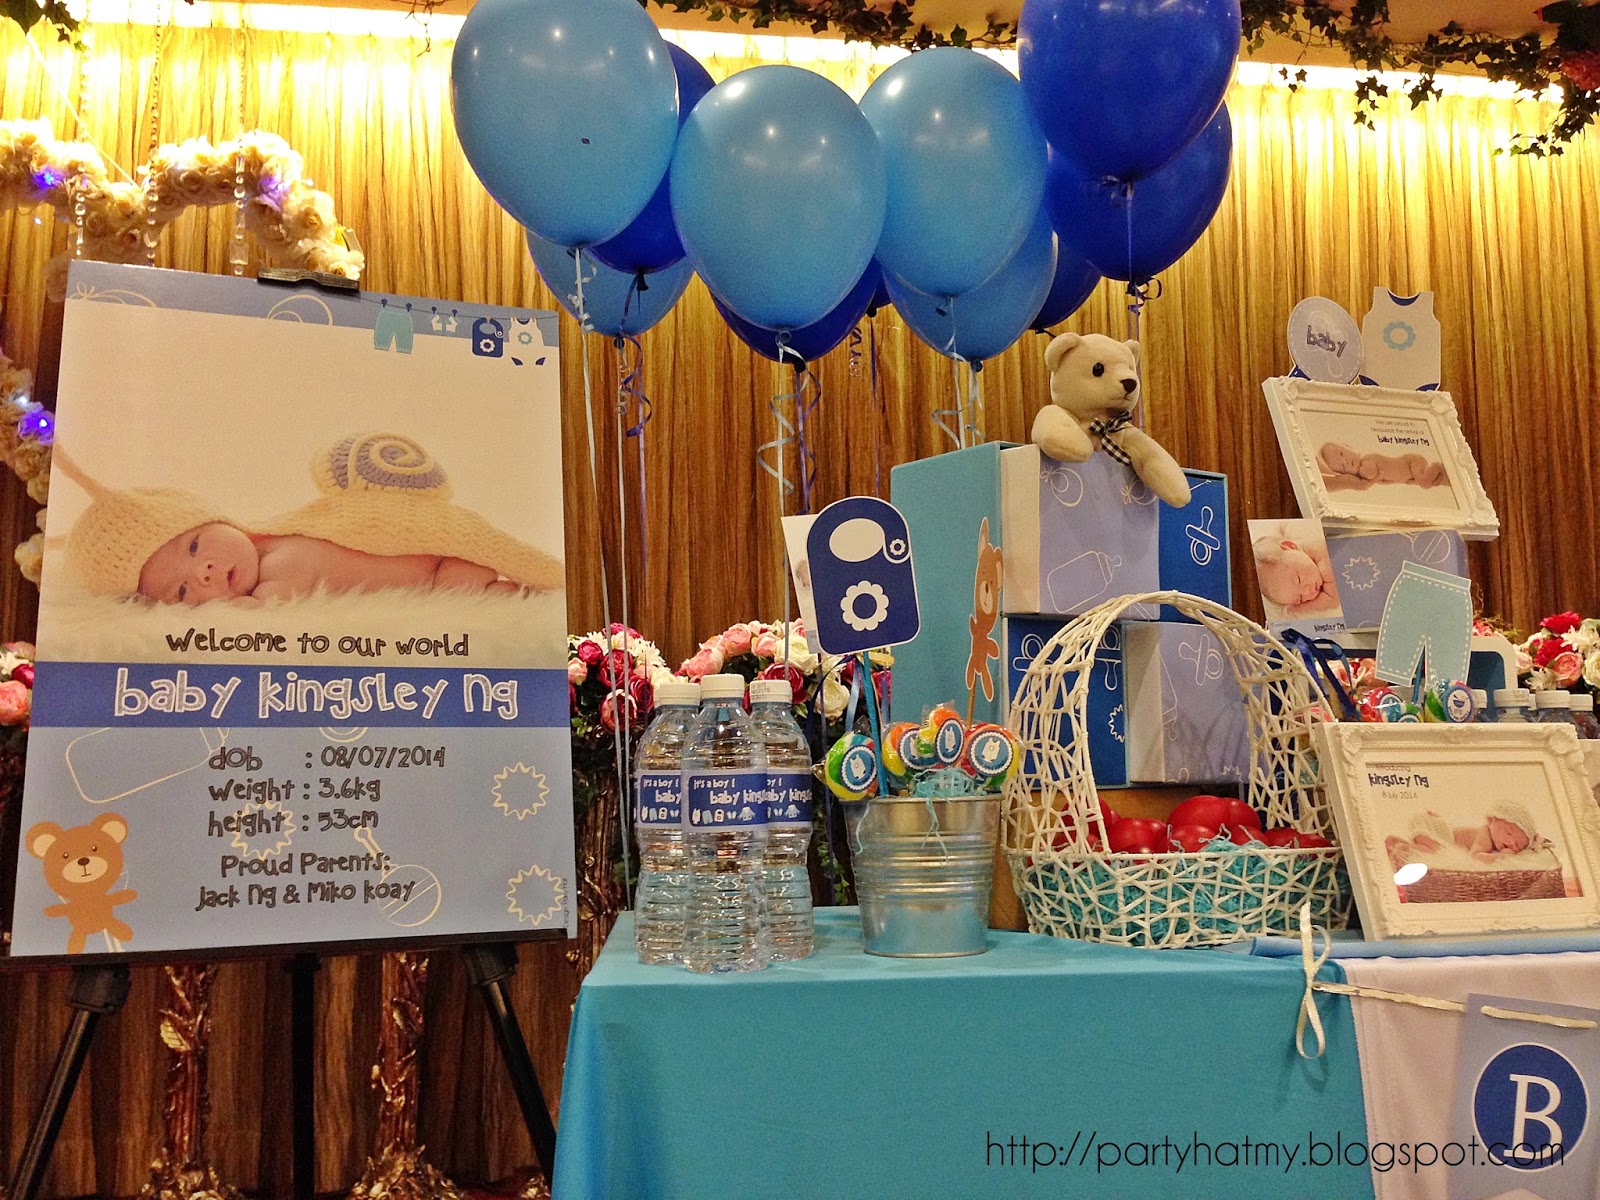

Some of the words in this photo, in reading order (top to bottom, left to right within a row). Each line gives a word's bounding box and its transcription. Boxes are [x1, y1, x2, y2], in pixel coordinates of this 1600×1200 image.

[1307, 325, 1348, 358] baby
[298, 632, 330, 654] to
[338, 635, 387, 657] our
[395, 633, 469, 657] world
[114, 667, 242, 719] baby
[259, 671, 449, 720] kingsley
[320, 745, 446, 769] 08/07/2014
[318, 776, 381, 802] 3.6kg
[658, 779, 673, 788] boy
[713, 779, 729, 788] boy
[1368, 773, 1411, 788] kingsley
[710, 790, 740, 805] baby
[767, 788, 787, 803] aby
[208, 810, 286, 837] height
[221, 853, 293, 878] Proud
[283, 884, 300, 904] &
[1503, 1073, 1563, 1160] B
